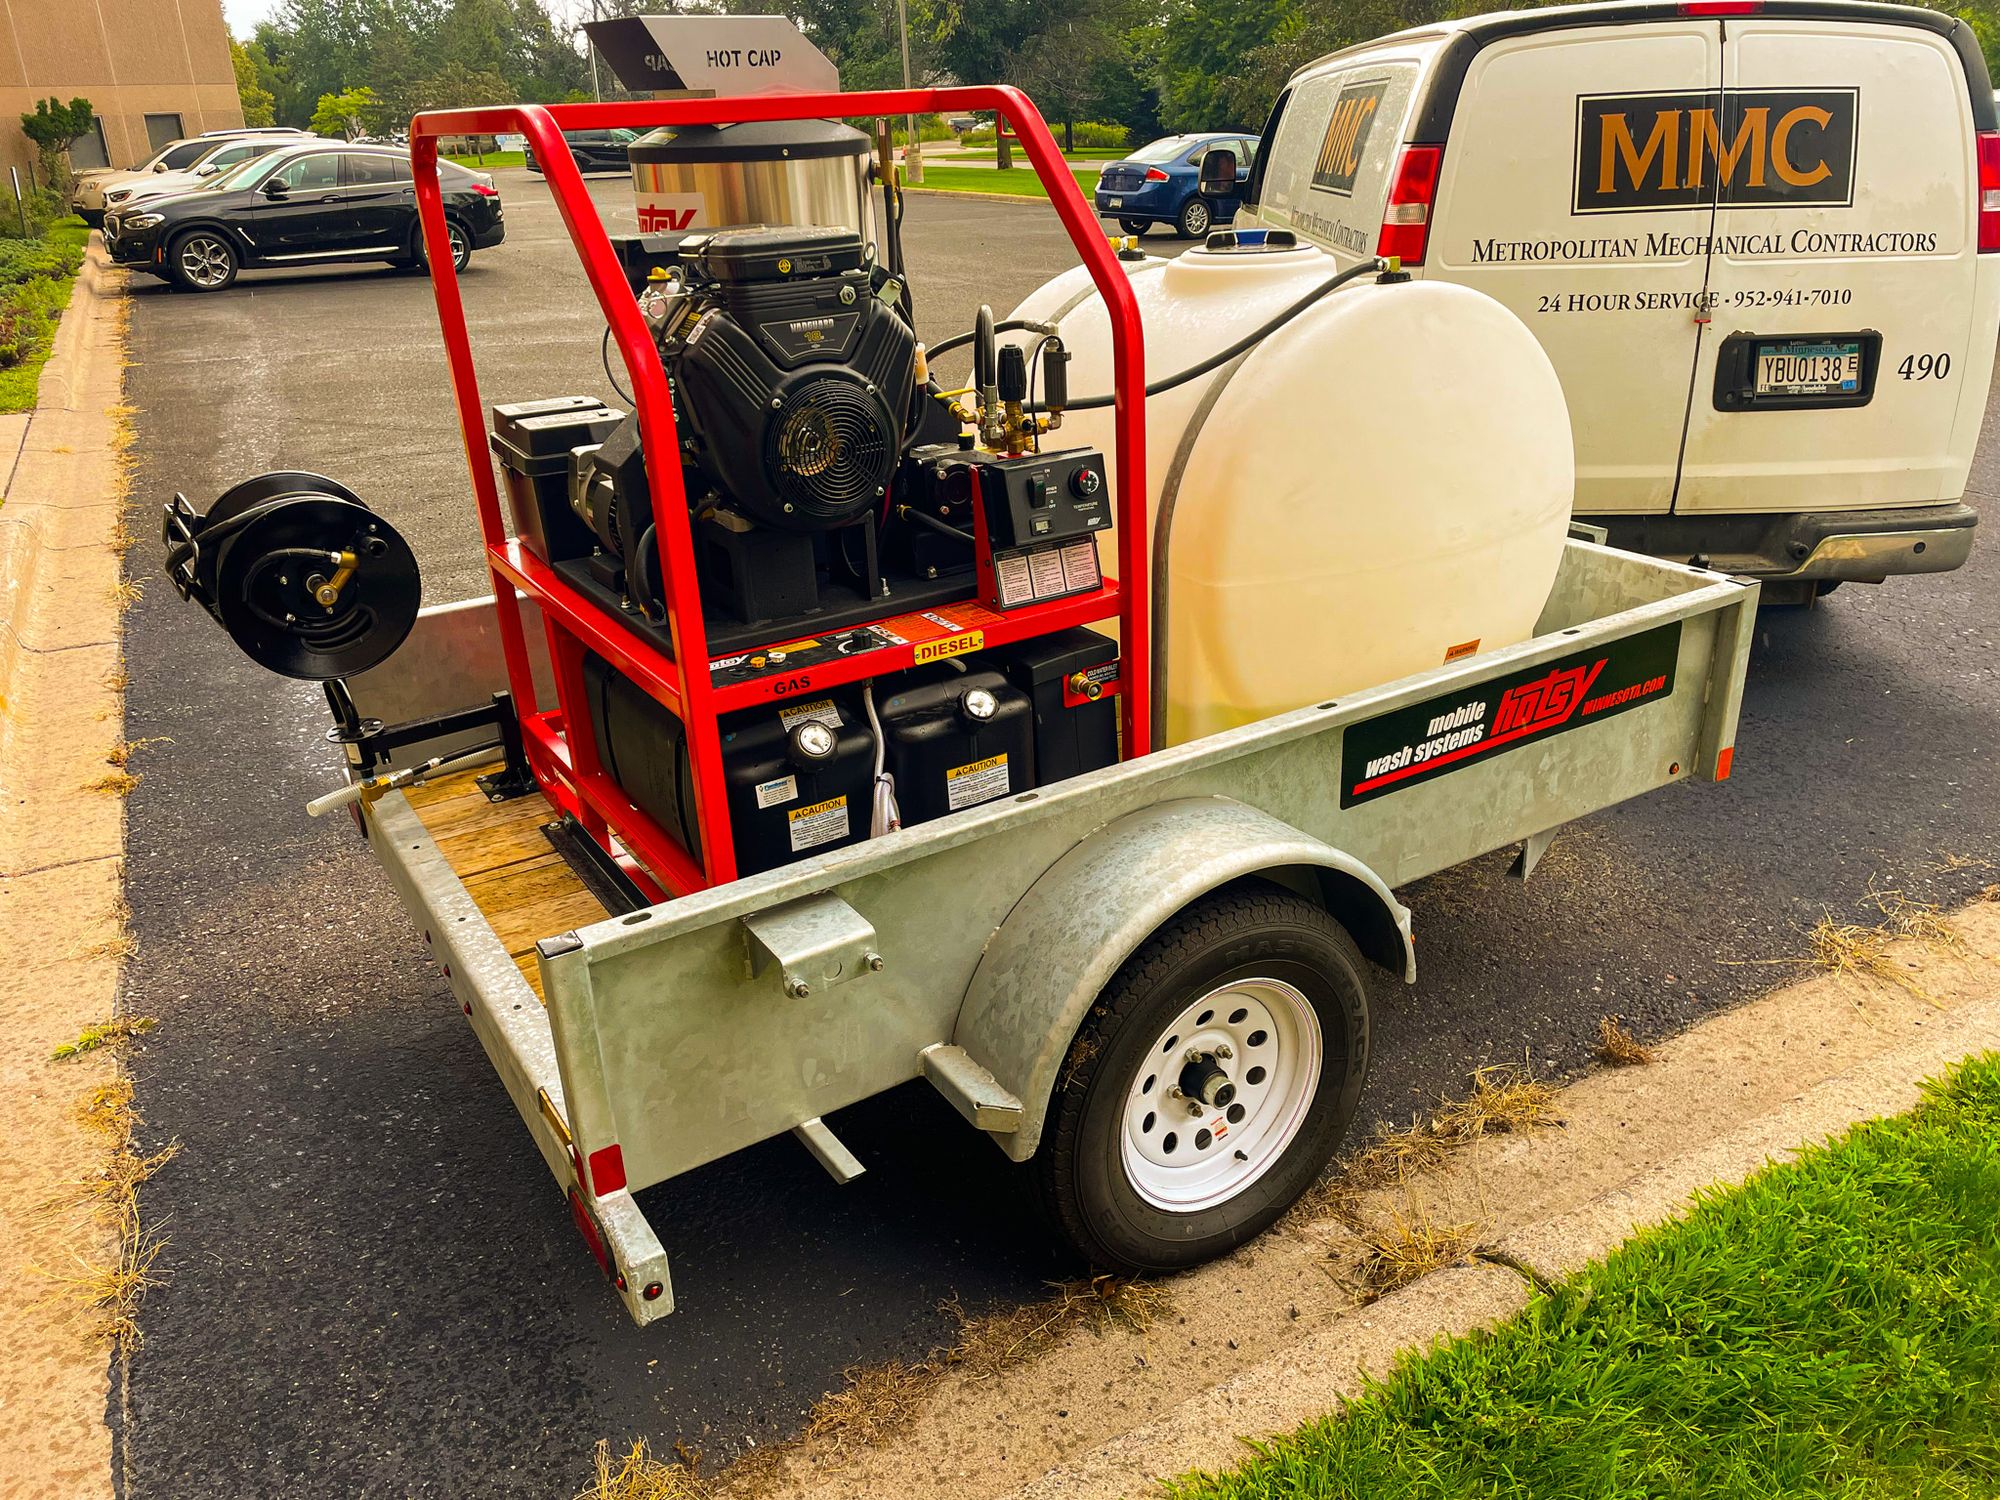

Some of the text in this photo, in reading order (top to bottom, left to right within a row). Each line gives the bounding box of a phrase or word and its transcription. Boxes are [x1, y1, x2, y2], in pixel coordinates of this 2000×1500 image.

[706, 49, 781, 67] HOT CAP
[1317, 96, 1376, 177] MMC
[1596, 105, 1833, 193] MMC
[1333, 218, 1369, 254] CONTRACTORS
[1471, 229, 1937, 262] METROPOLITAN MECHANICAL CONTRACTORS
[1538, 293, 1561, 312] 24
[1567, 293, 1630, 312] HOUR
[1634, 291, 1719, 310] SERVICE
[1734, 288, 1851, 308] 952-941-7010
[790, 319, 834, 333] VANGUARD
[1848, 356, 1858, 369] E
[1898, 353, 1951, 381] 490
[921, 637, 978, 660] DIESEL
[773, 676, 811, 694] GAS
[790, 700, 830, 718] CAUTION
[1489, 658, 1667, 737] hotsy MINNESOTA.COM
[1427, 701, 1487, 737] mobile
[1365, 724, 1485, 779] wash systems
[962, 757, 997, 774] CAUTION
[800, 798, 841, 817] CAUTION
